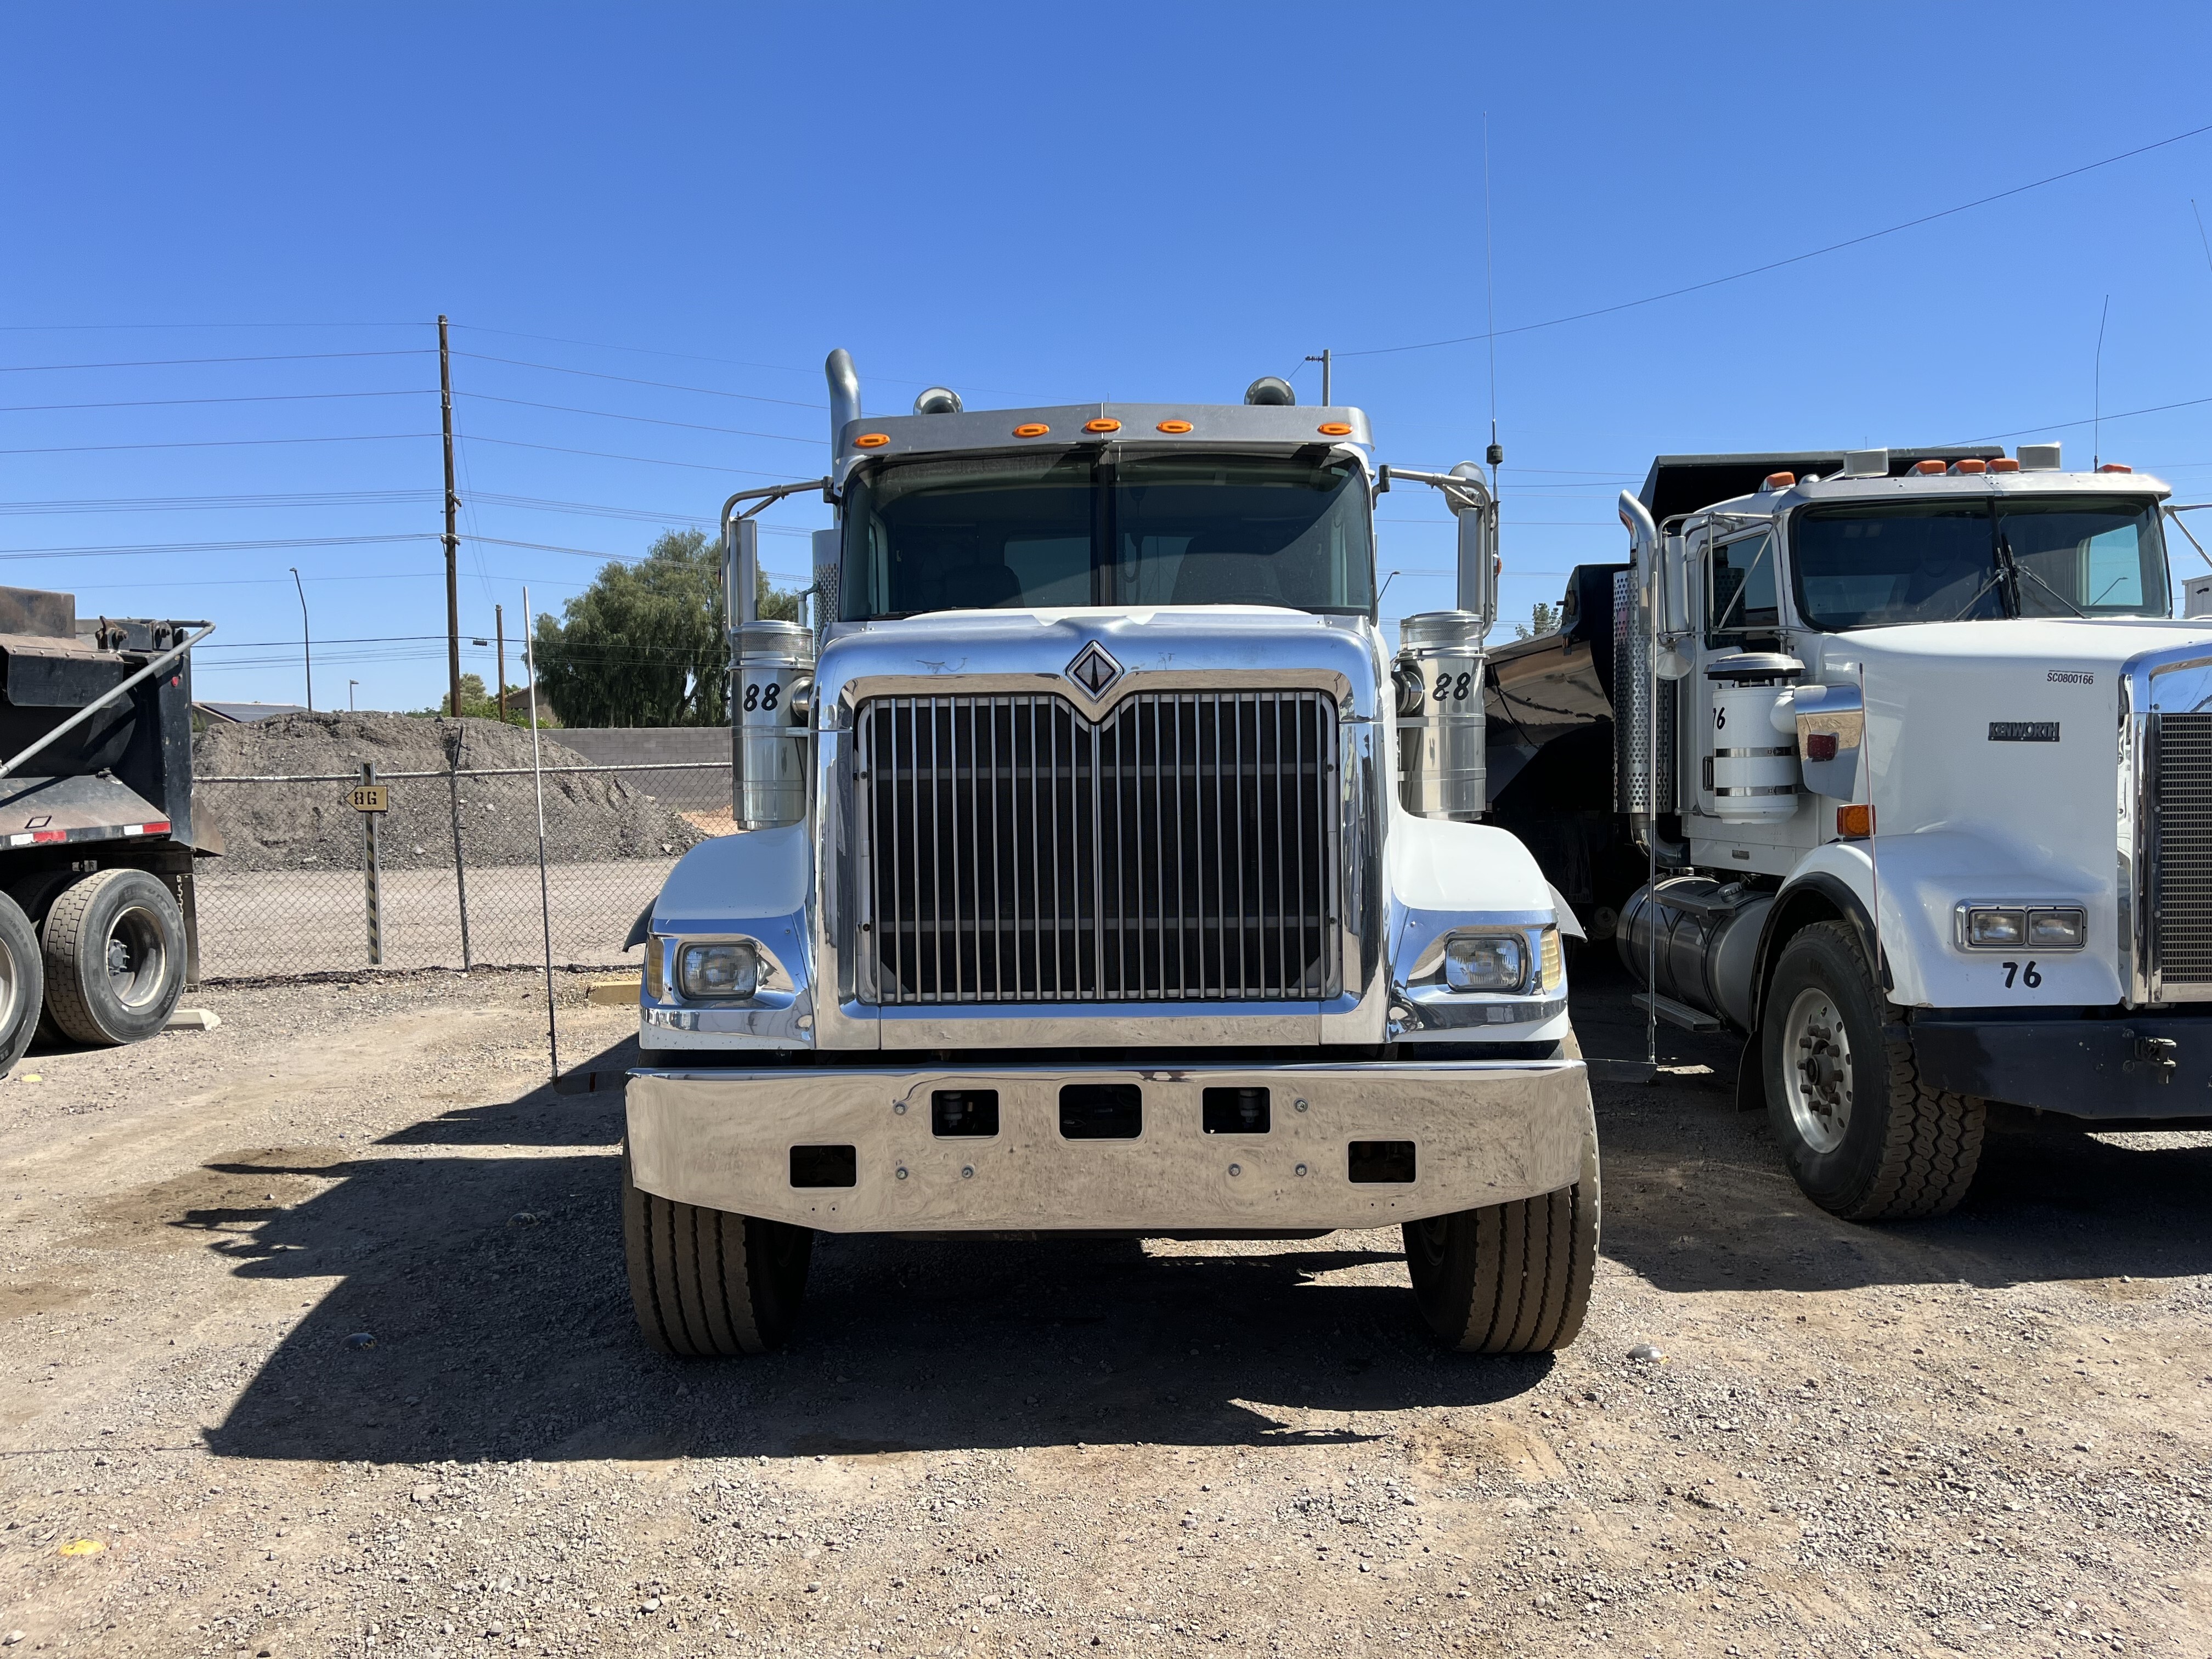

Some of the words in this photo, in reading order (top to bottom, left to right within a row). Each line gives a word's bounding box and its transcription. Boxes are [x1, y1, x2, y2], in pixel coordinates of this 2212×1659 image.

[1432, 672, 1471, 701] 88
[2047, 673, 2094, 685] SC0800166
[743, 683, 780, 712] 88
[1989, 722, 2059, 738] KENWORTH
[2002, 961, 2042, 989] 76
